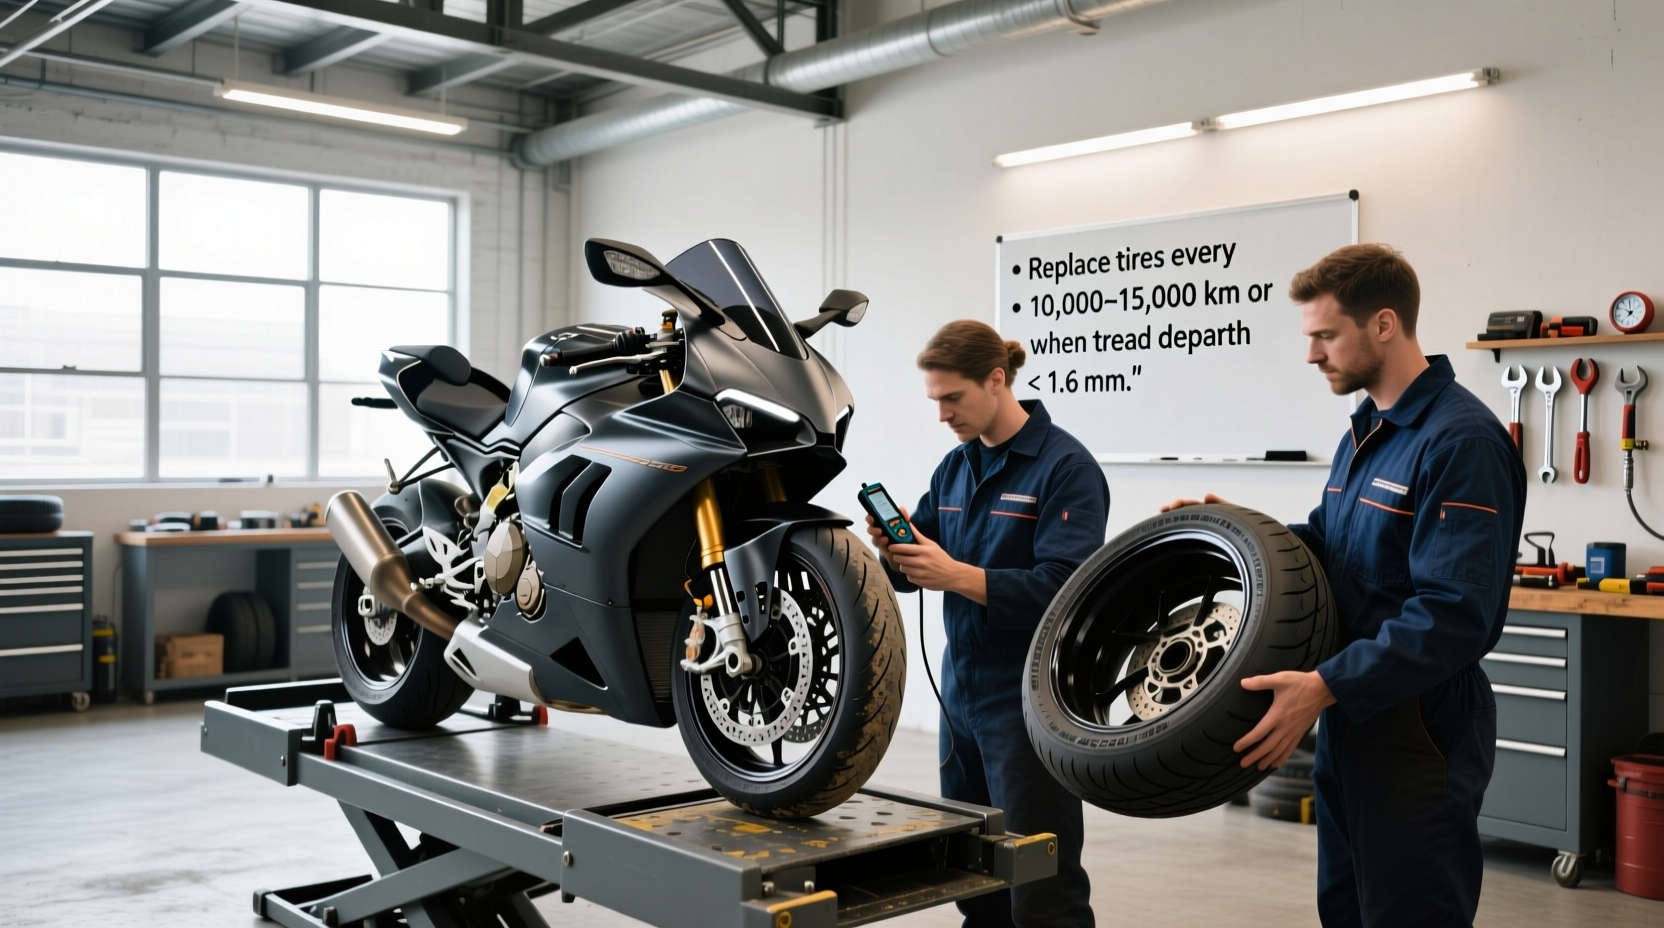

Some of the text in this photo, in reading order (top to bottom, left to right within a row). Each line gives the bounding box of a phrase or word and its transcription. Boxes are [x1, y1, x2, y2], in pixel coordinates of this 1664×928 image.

[1029, 242, 1237, 285] Replace tires every
[1205, 280, 1240, 306] km
[1247, 283, 1274, 303] or
[1030, 320, 1251, 355] when tread departh
[1028, 375, 1041, 391] <
[1048, 370, 1079, 394] 1.6
